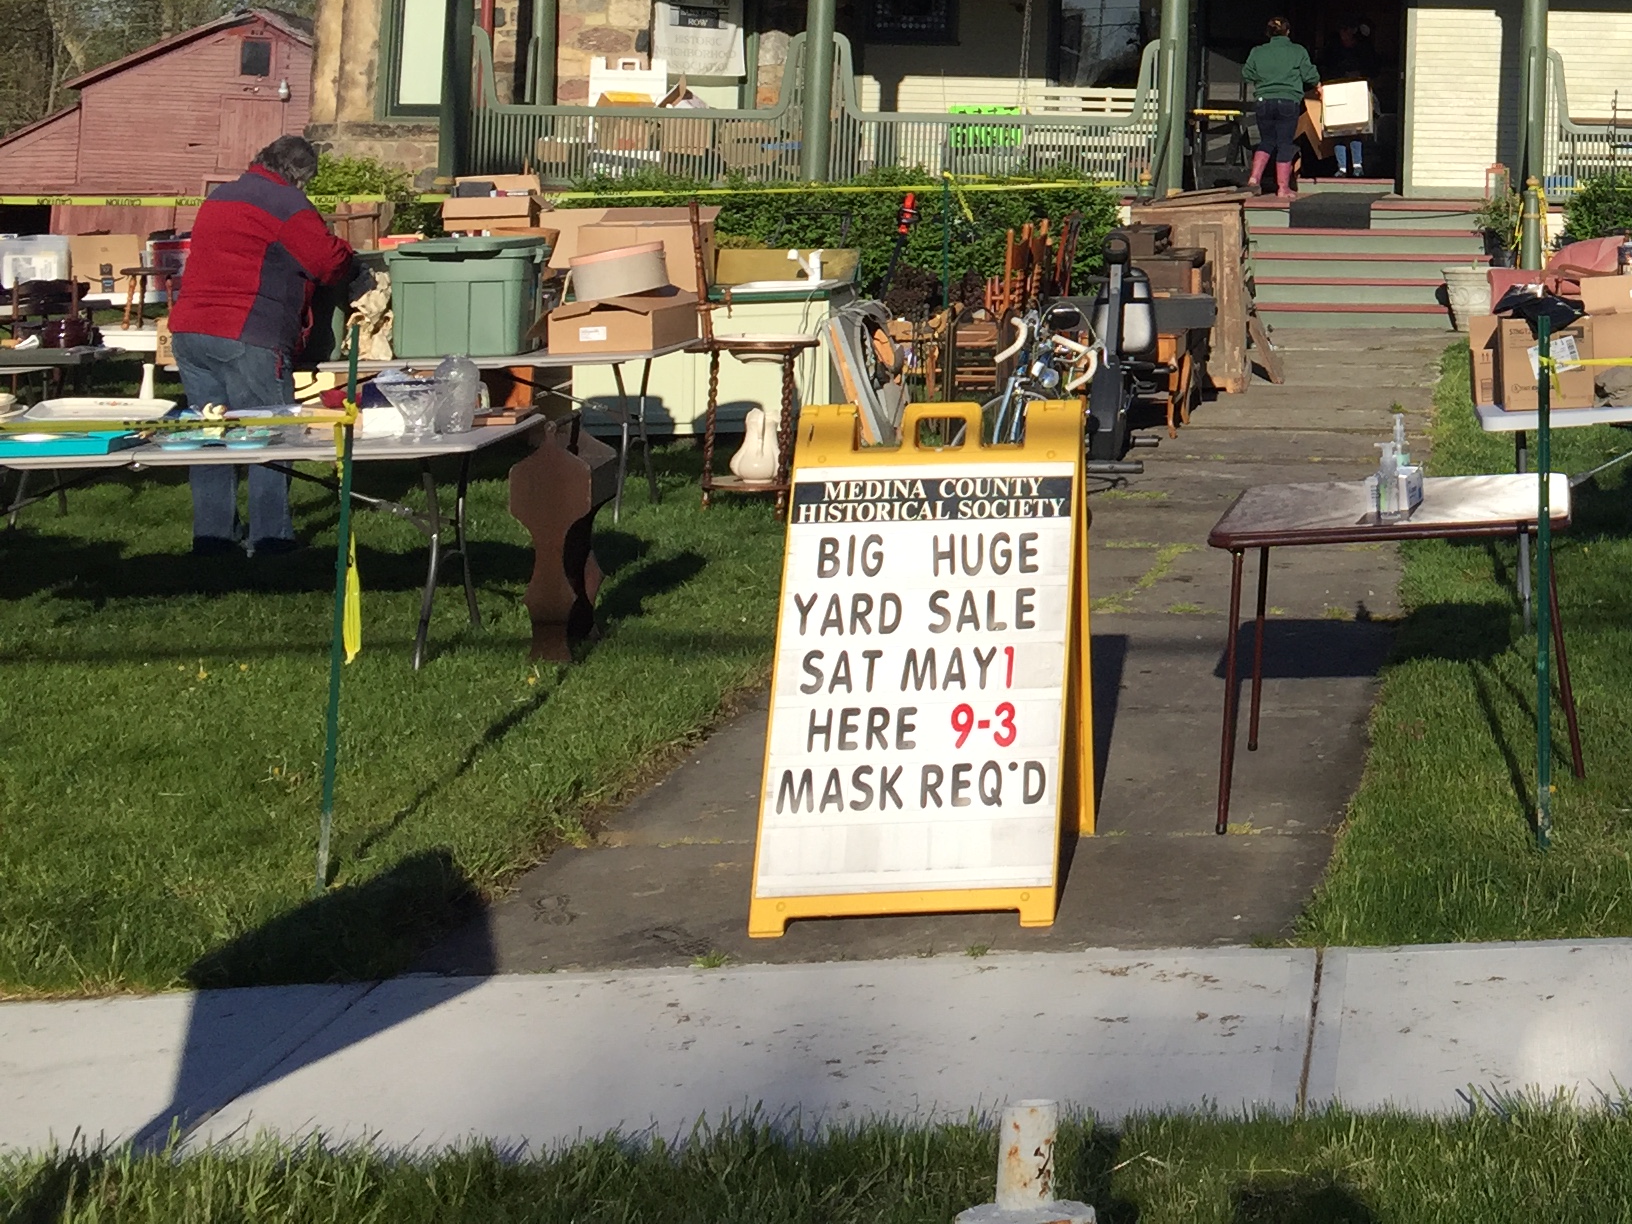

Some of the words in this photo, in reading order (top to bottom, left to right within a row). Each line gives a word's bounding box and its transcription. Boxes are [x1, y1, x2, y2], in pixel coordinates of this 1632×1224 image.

[687, 18, 709, 27] ROW
[674, 34, 721, 47] HISTORIC
[655, 46, 737, 59] NEIGHBORHOOD
[37, 198, 72, 206] CAUTION
[105, 198, 142, 206] CAUTION
[314, 195, 351, 204] CAUTION
[385, 194, 422, 203] CAUTION
[823, 480, 927, 502] MEDINA
[938, 477, 1045, 499] COUNTY
[797, 500, 950, 523] HISTORICAL
[957, 498, 1065, 519] SOCIETY
[817, 534, 884, 578] BIG
[932, 532, 1039, 577] HUGE
[794, 592, 902, 636] YARD
[928, 587, 1036, 633] SALE
[800, 649, 883, 695] SAT
[806, 707, 918, 752] HERE
[950, 701, 1017, 749] 9-3
[775, 765, 904, 815] MASK
[920, 759, 1046, 809] REQ'D
